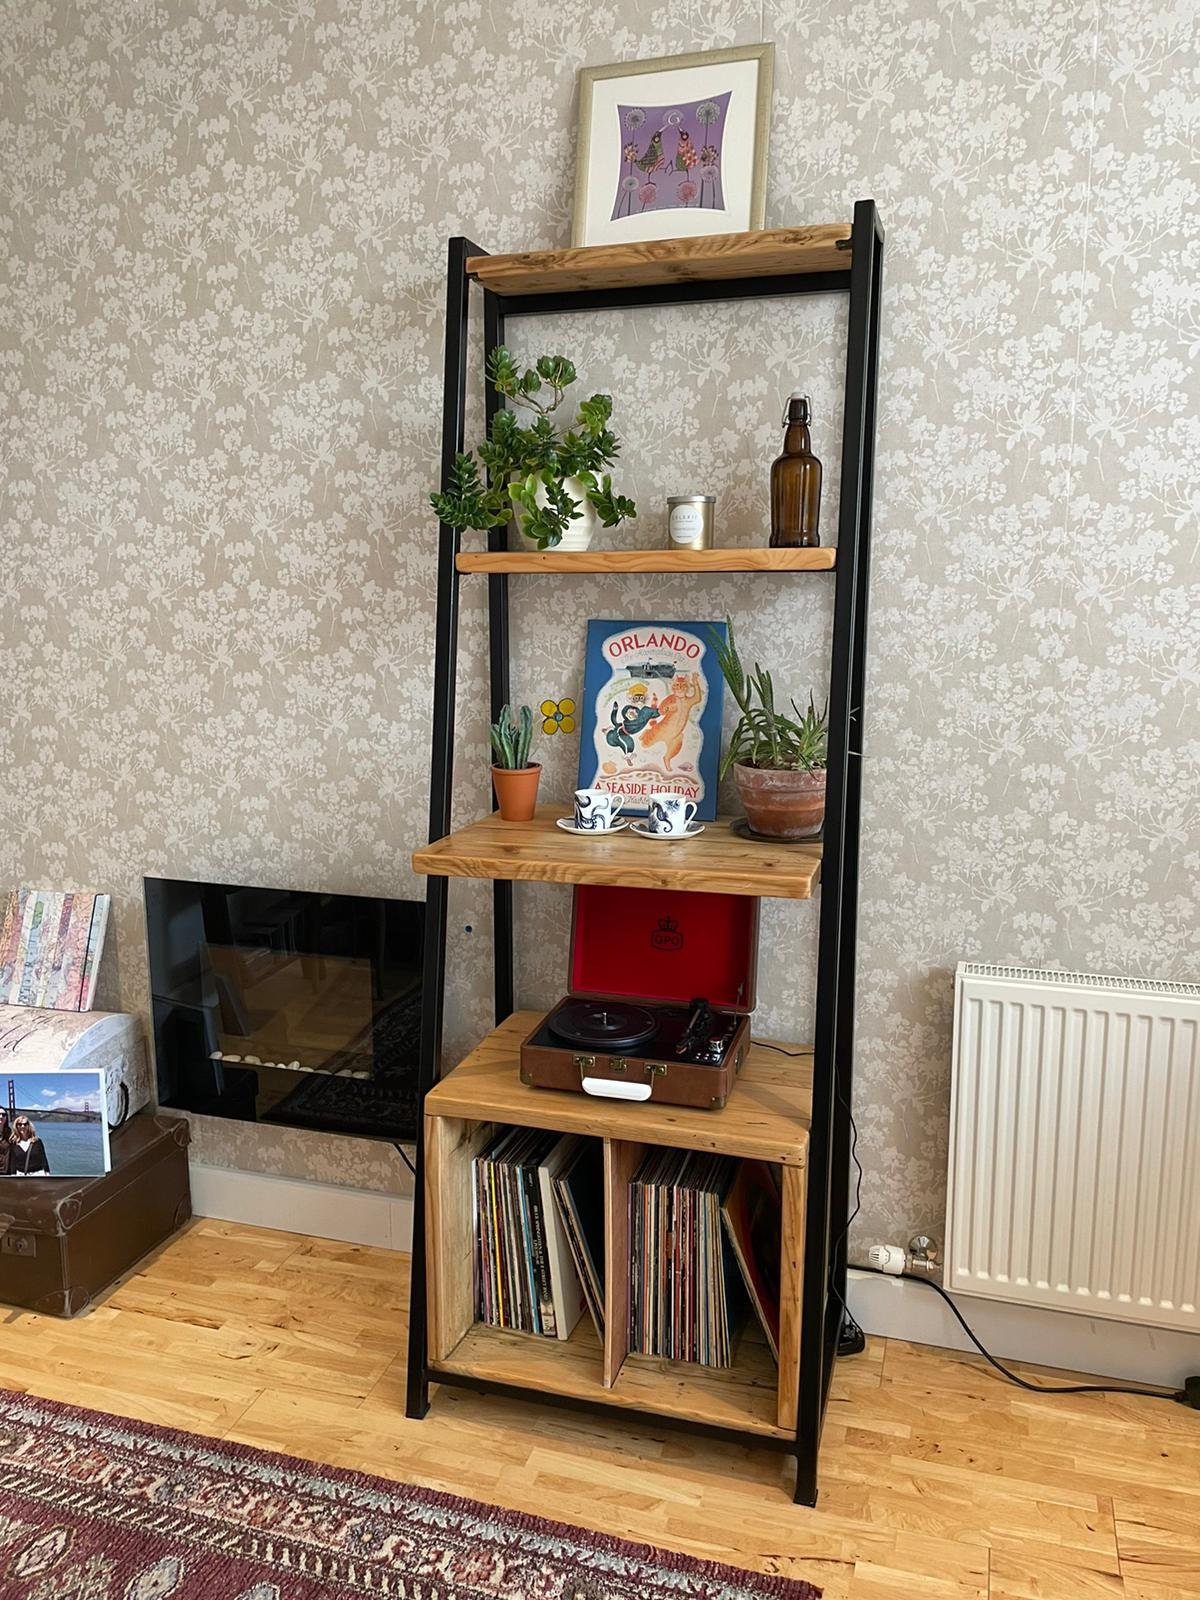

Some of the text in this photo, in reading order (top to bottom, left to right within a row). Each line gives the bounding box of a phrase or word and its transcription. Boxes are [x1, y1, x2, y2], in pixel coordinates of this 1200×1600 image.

[608, 633, 701, 659] ORLANDO
[607, 783, 647, 795] SEASIDE
[650, 784, 700, 798] HOLIDAY
